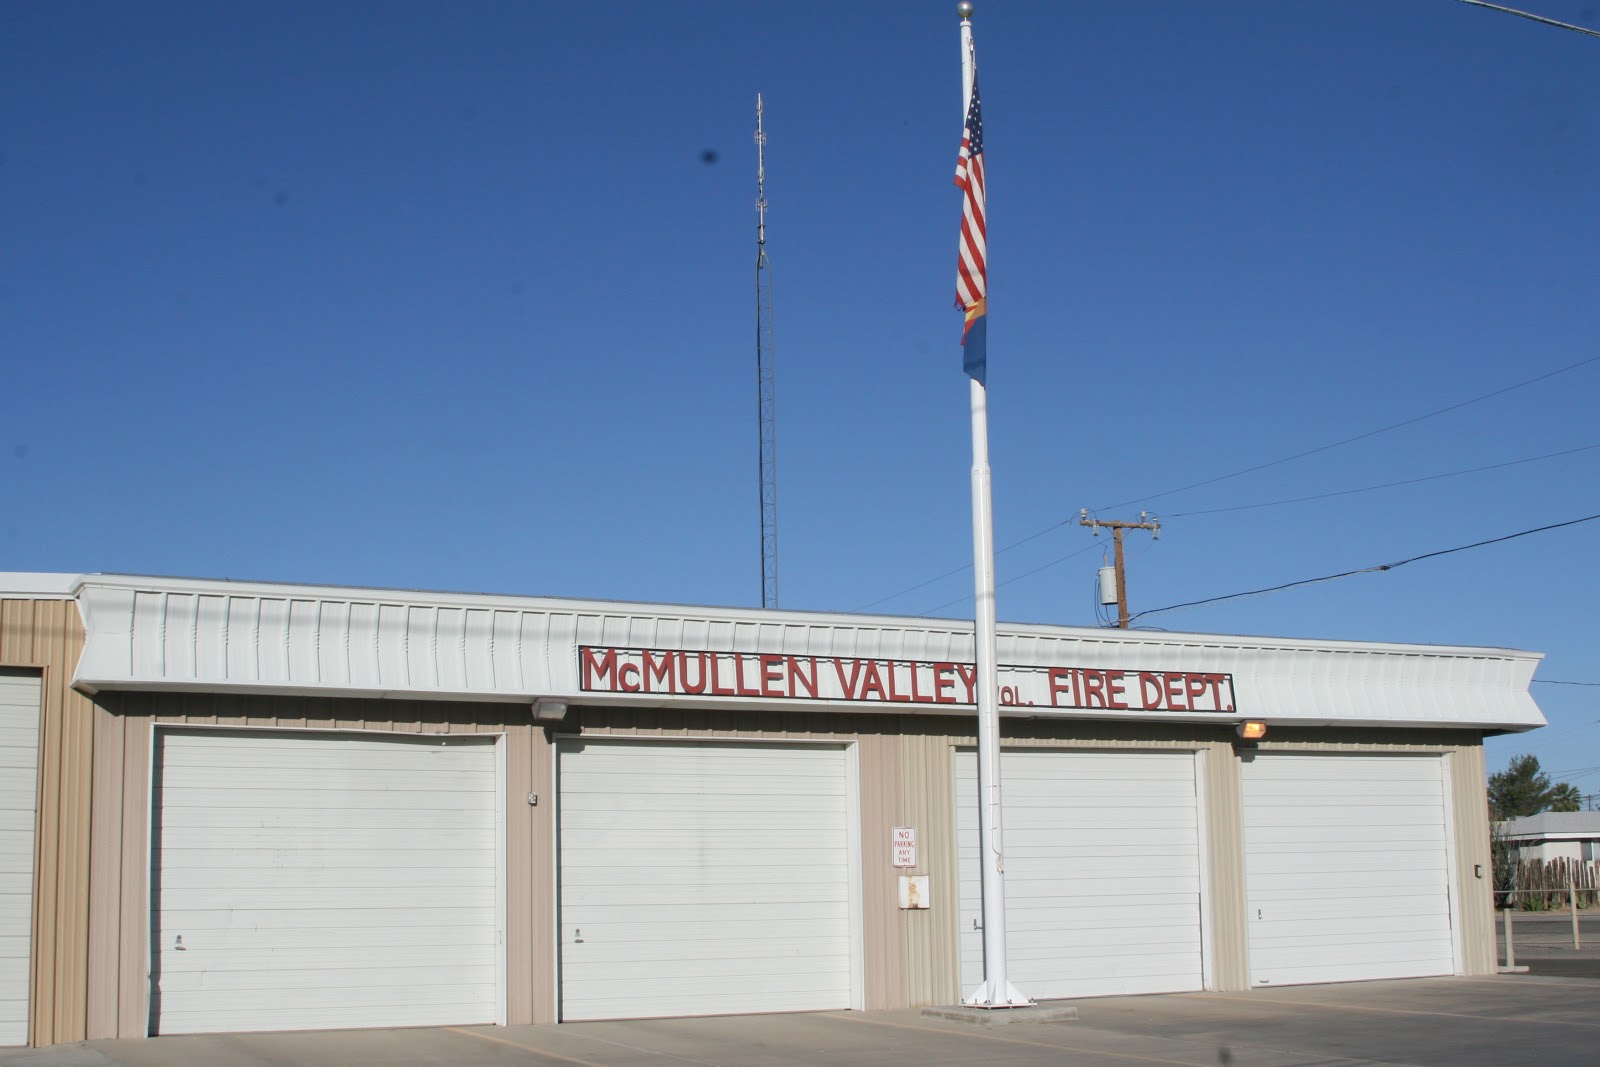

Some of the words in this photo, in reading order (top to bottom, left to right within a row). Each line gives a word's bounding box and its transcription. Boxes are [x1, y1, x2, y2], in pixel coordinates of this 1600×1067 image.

[582, 646, 818, 698] McMULLEN
[833, 656, 977, 705] VALLEY
[997, 685, 1034, 706] OL.
[1048, 667, 1128, 710] FIRE
[1139, 671, 1234, 712] DEPT.
[898, 831, 910, 839] NO
[894, 840, 915, 848] PARKING
